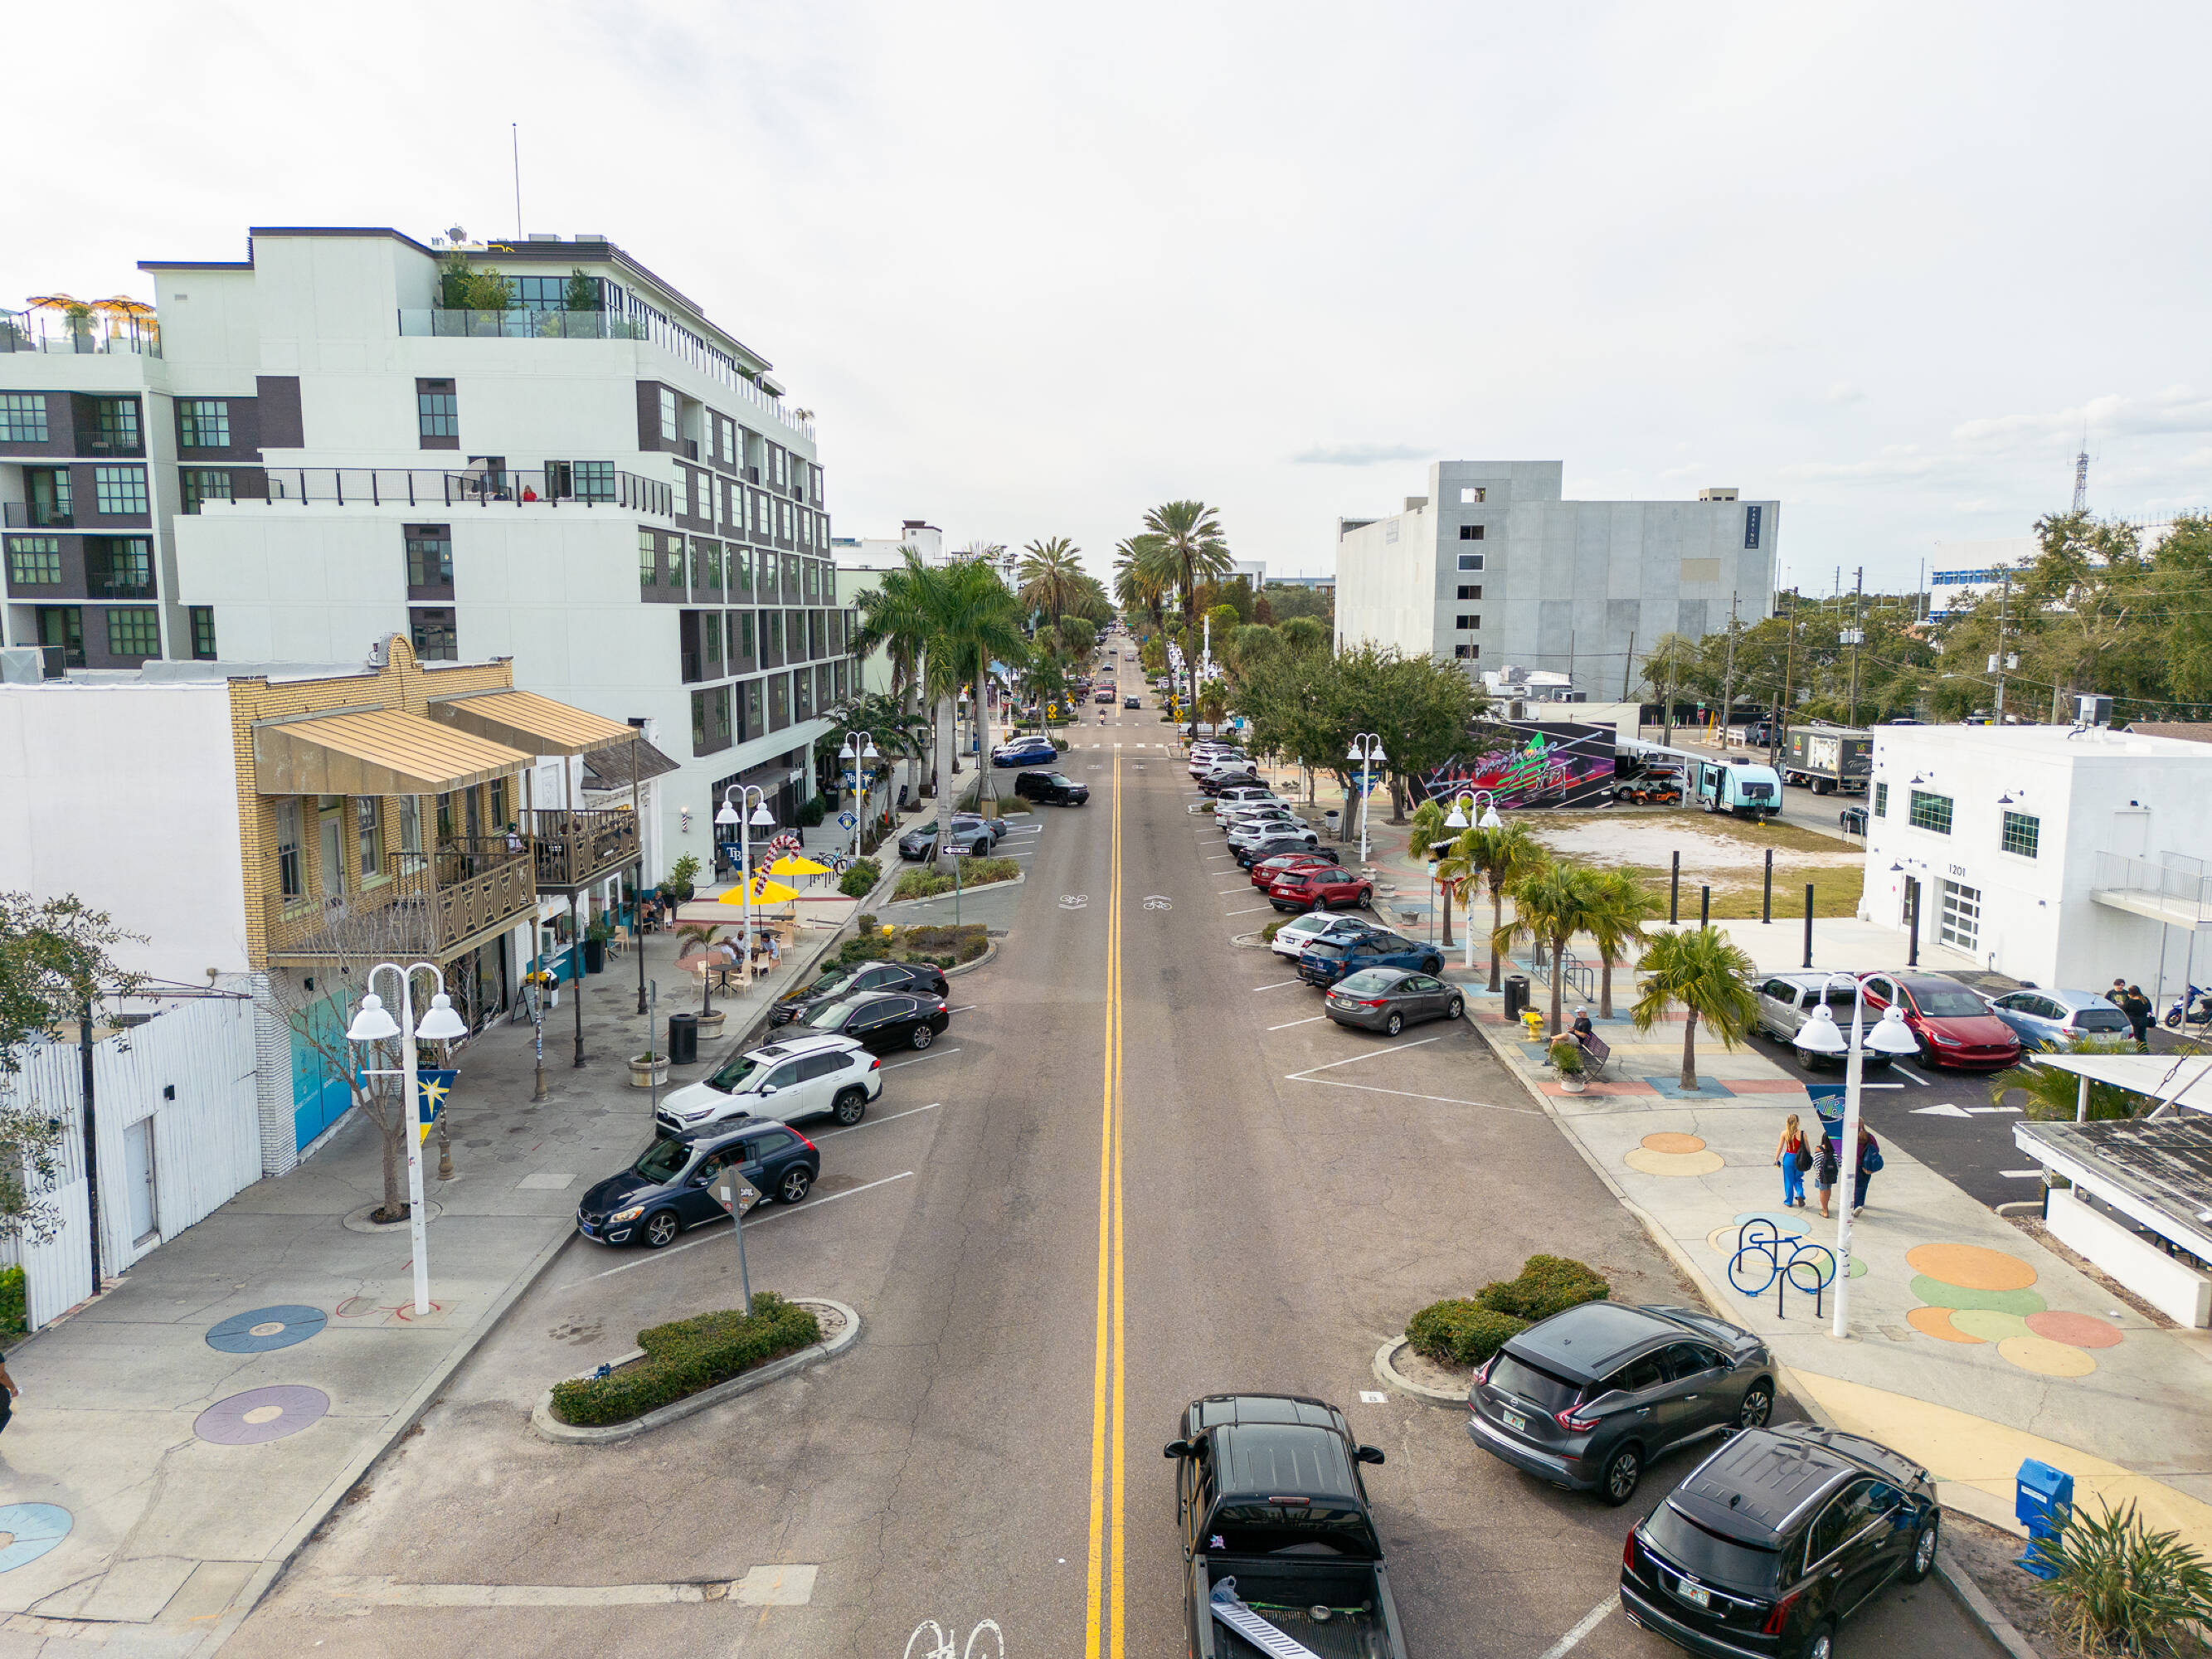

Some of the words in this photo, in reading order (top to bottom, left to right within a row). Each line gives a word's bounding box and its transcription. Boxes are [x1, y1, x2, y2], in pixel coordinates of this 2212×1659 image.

[1749, 507, 1757, 543] PARKING
[845, 772, 856, 783] TB
[727, 847, 742, 861] TB
[1949, 863, 1966, 877] 1201
